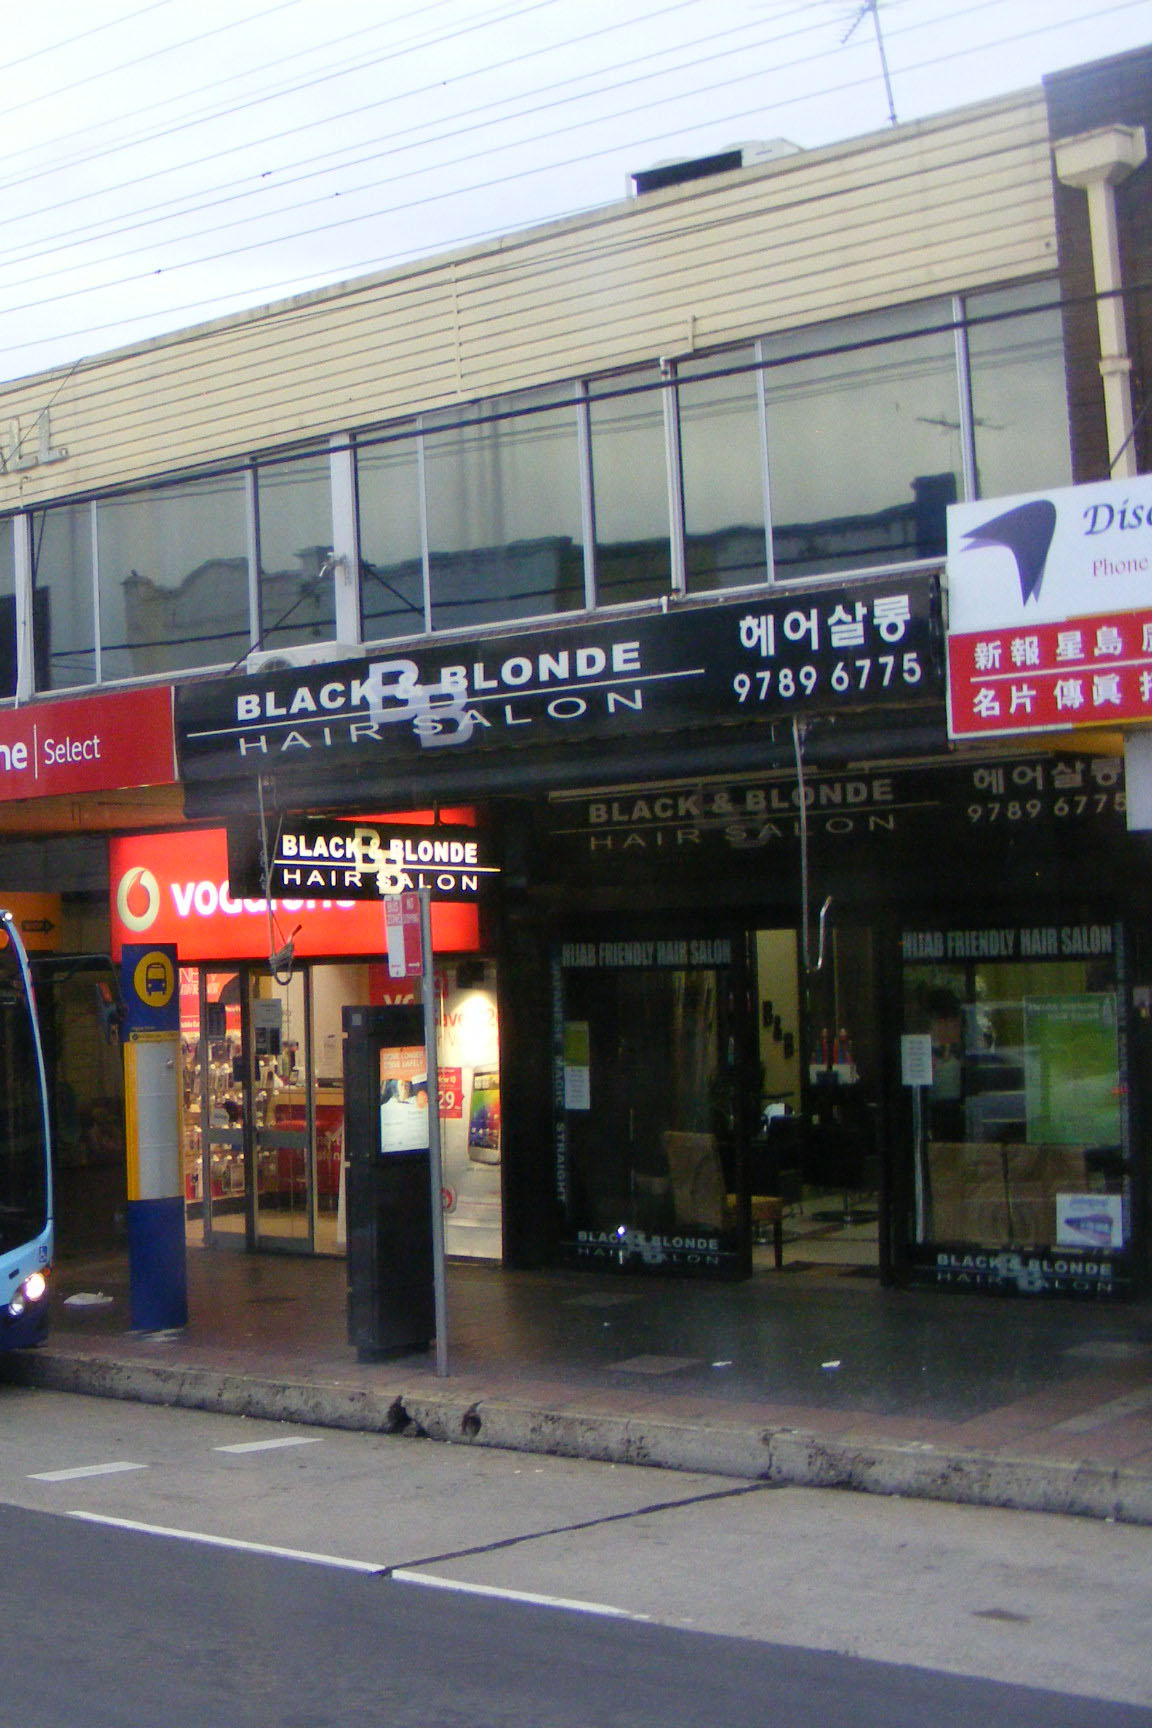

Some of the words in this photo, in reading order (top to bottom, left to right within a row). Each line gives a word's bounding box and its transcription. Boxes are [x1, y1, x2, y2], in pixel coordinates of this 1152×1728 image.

[237, 680, 377, 721] BLACK
[441, 641, 641, 693] BLONDE
[733, 665, 817, 703] 9789
[831, 653, 921, 691] 6775
[238, 722, 383, 756] HAIR
[413, 689, 644, 735] SALON
[44, 735, 101, 765] Select
[588, 794, 702, 824] BLACK
[712, 792, 734, 814] &
[746, 778, 895, 811] BLONDE
[968, 798, 1041, 823] 9789
[1054, 792, 1126, 816] 6775
[282, 834, 361, 858] BLACK
[390, 839, 477, 864] BLONDE
[590, 828, 702, 851] HAIR
[723, 813, 896, 842] SALON
[283, 868, 363, 887] HAIR
[377, 872, 478, 891] SALON
[599, 941, 655, 967] FRIENDLY
[657, 940, 688, 966] HAIR
[690, 938, 732, 965] SALON
[947, 928, 1016, 957] FRIENDLY
[1020, 926, 1059, 956] HAIR
[1061, 923, 1113, 955] SALON
[555, 1122, 566, 1203] STRAIGHT
[937, 1254, 1001, 1269] BLACK
[1028, 1258, 1112, 1276] BLONDE
